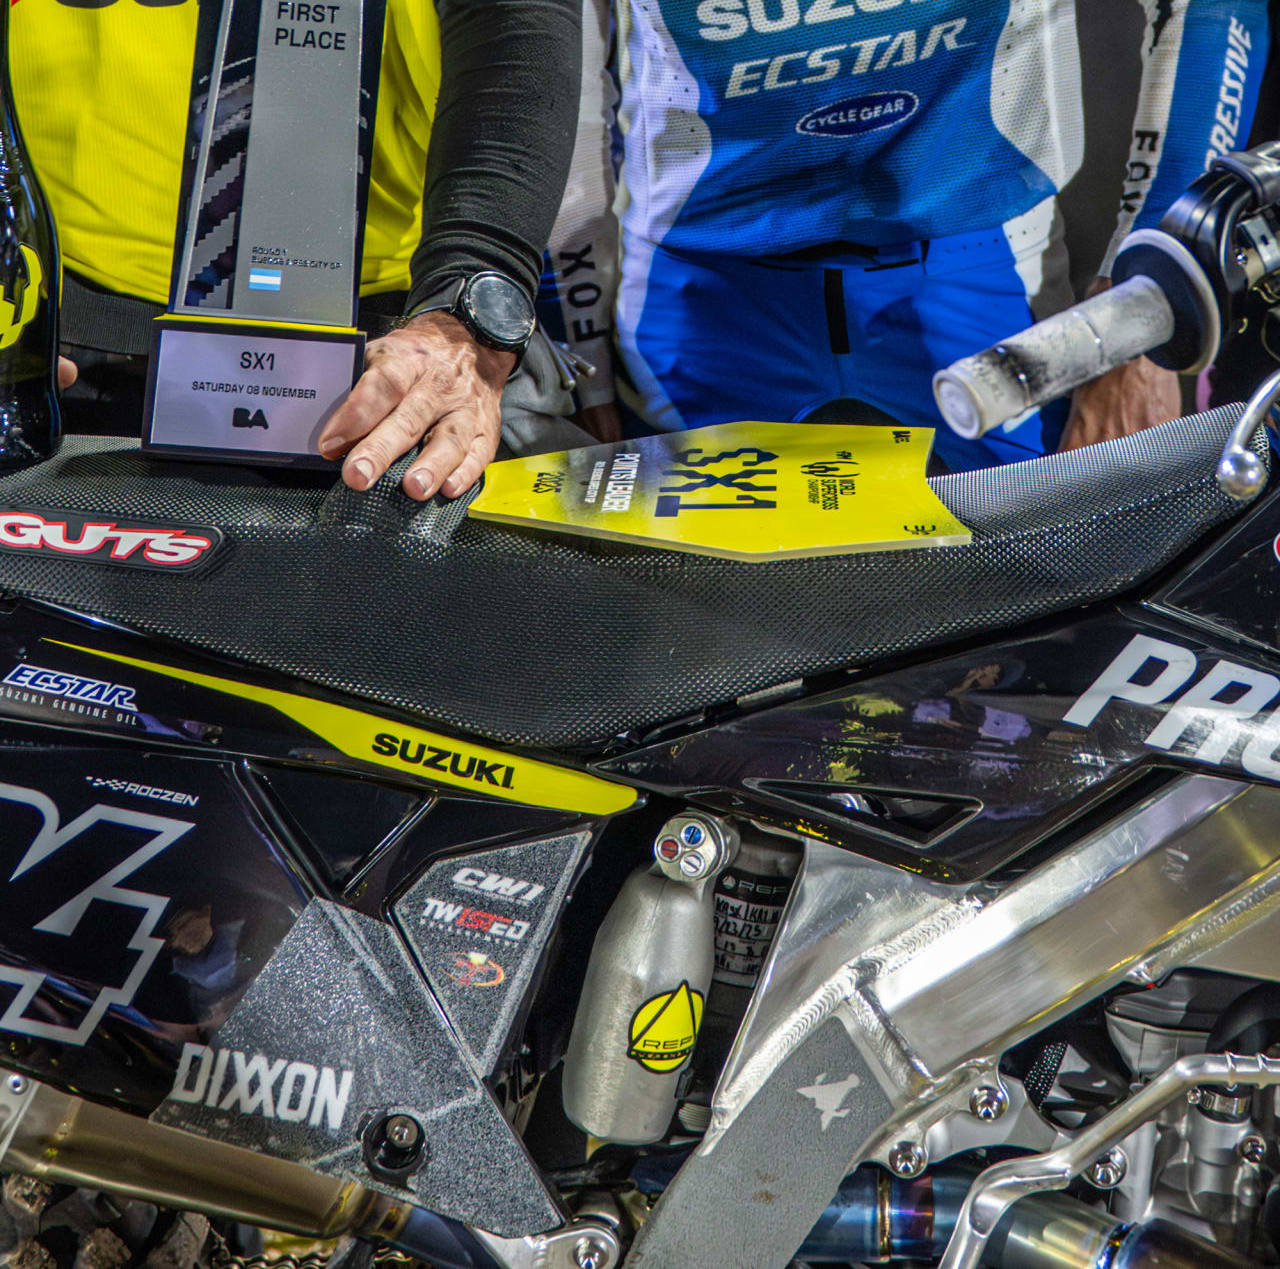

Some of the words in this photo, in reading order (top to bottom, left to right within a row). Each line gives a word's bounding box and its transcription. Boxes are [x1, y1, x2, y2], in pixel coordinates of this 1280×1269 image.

[276, 1, 341, 24] FIRST
[273, 27, 347, 52] PLACE
[724, 16, 977, 100] ECSTAR
[805, 107, 860, 132] CYCLE
[859, 98, 907, 123] GEAR
[658, 222, 715, 264] Red
[717, 222, 781, 251] Bull
[558, 241, 604, 344] FOX
[239, 351, 276, 371] SX1
[191, 380, 246, 395] SATURDAY
[246, 385, 261, 396] 08
[262, 386, 317, 400] NOVEMBER
[607, 452, 641, 481] POINTS
[654, 447, 780, 519] SX1
[600, 480, 636, 513] LEADER
[1, 662, 140, 713] ECSTAR
[52, 698, 110, 721] GENUINE
[116, 712, 139, 726] OIL
[370, 731, 517, 791] SUZUKI
[122, 781, 200, 807] ROCZEN
[642, 1034, 693, 1050] REP
[171, 1040, 355, 1133] DIXXON
